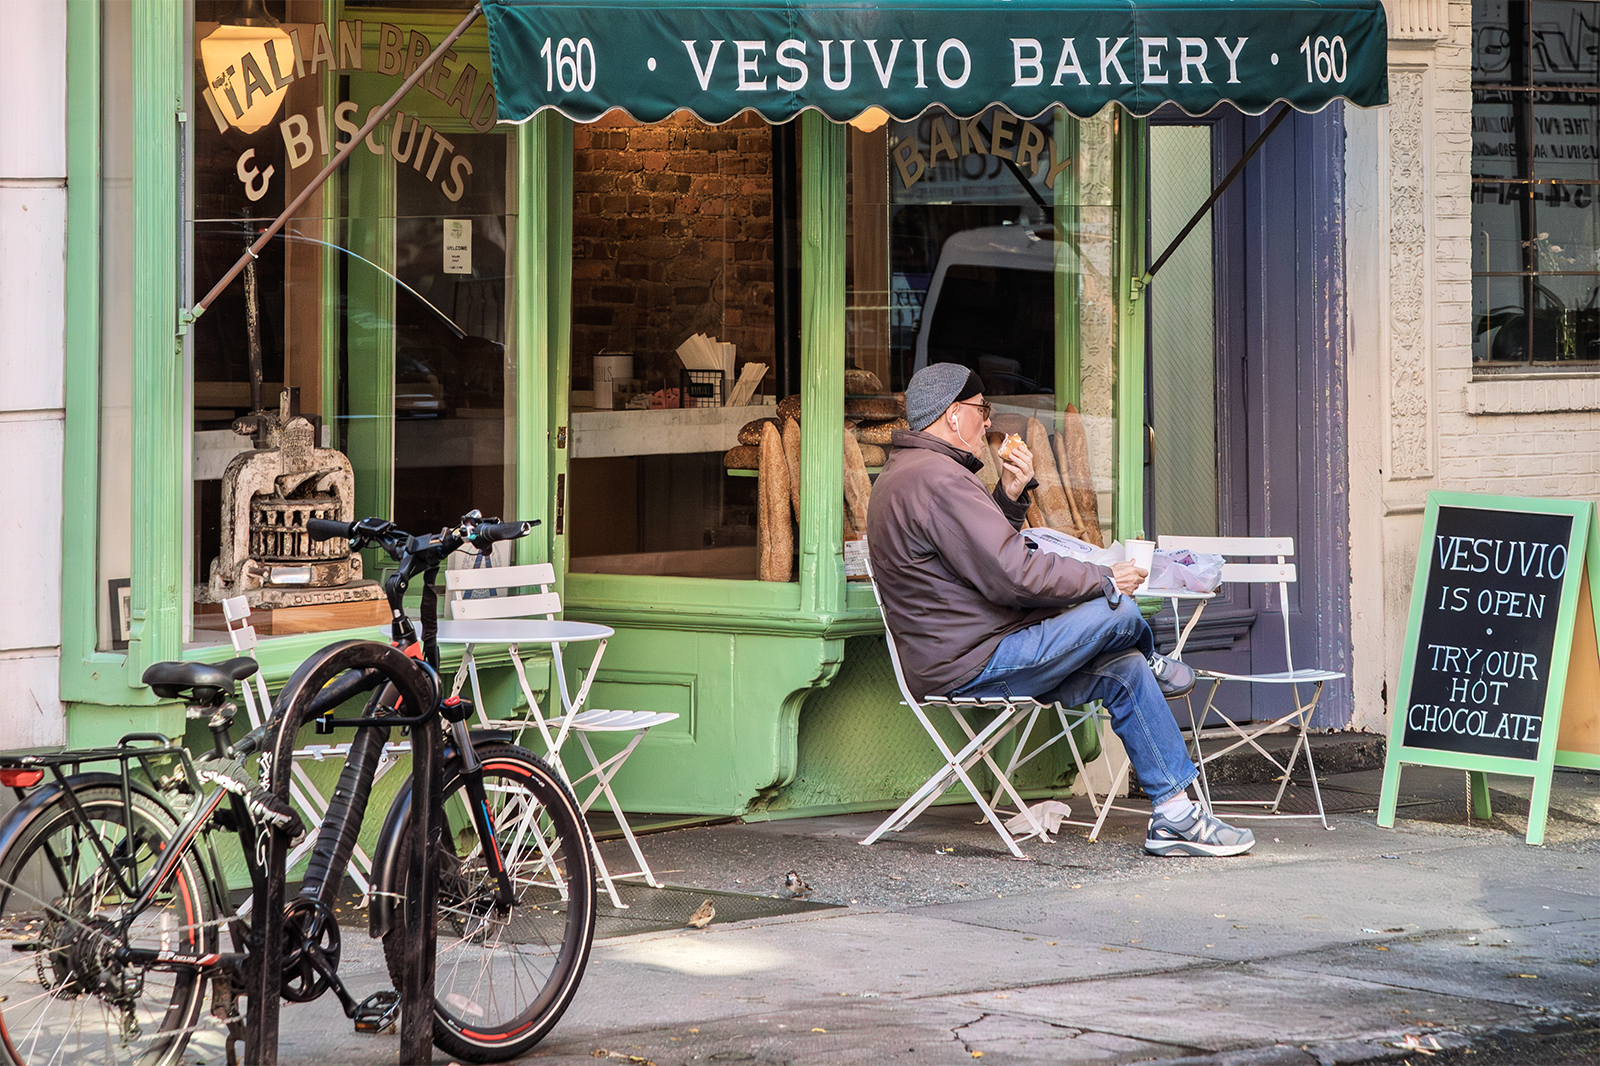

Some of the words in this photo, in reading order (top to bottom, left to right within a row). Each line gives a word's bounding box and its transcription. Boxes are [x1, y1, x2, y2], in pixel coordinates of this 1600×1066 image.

[203, 20, 363, 134] ITALIAN
[378, 22, 498, 134] BREAD
[540, 37, 596, 92] 160
[681, 37, 972, 92] VESUVIO
[1010, 37, 1249, 88] BAKERY
[1300, 35, 1348, 83] 160
[236, 148, 275, 202] &
[279, 101, 474, 202] BISCUITS
[892, 109, 1072, 190] BAKERY
[1436, 534, 1568, 580] VESUVIO
[1438, 586, 1470, 612] IS
[1477, 588, 1547, 619] OPEN
[1428, 643, 1483, 675] TRY
[1485, 650, 1539, 681] OUR
[1449, 677, 1509, 706] HOT
[1408, 703, 1543, 743] CHOCOLATE
